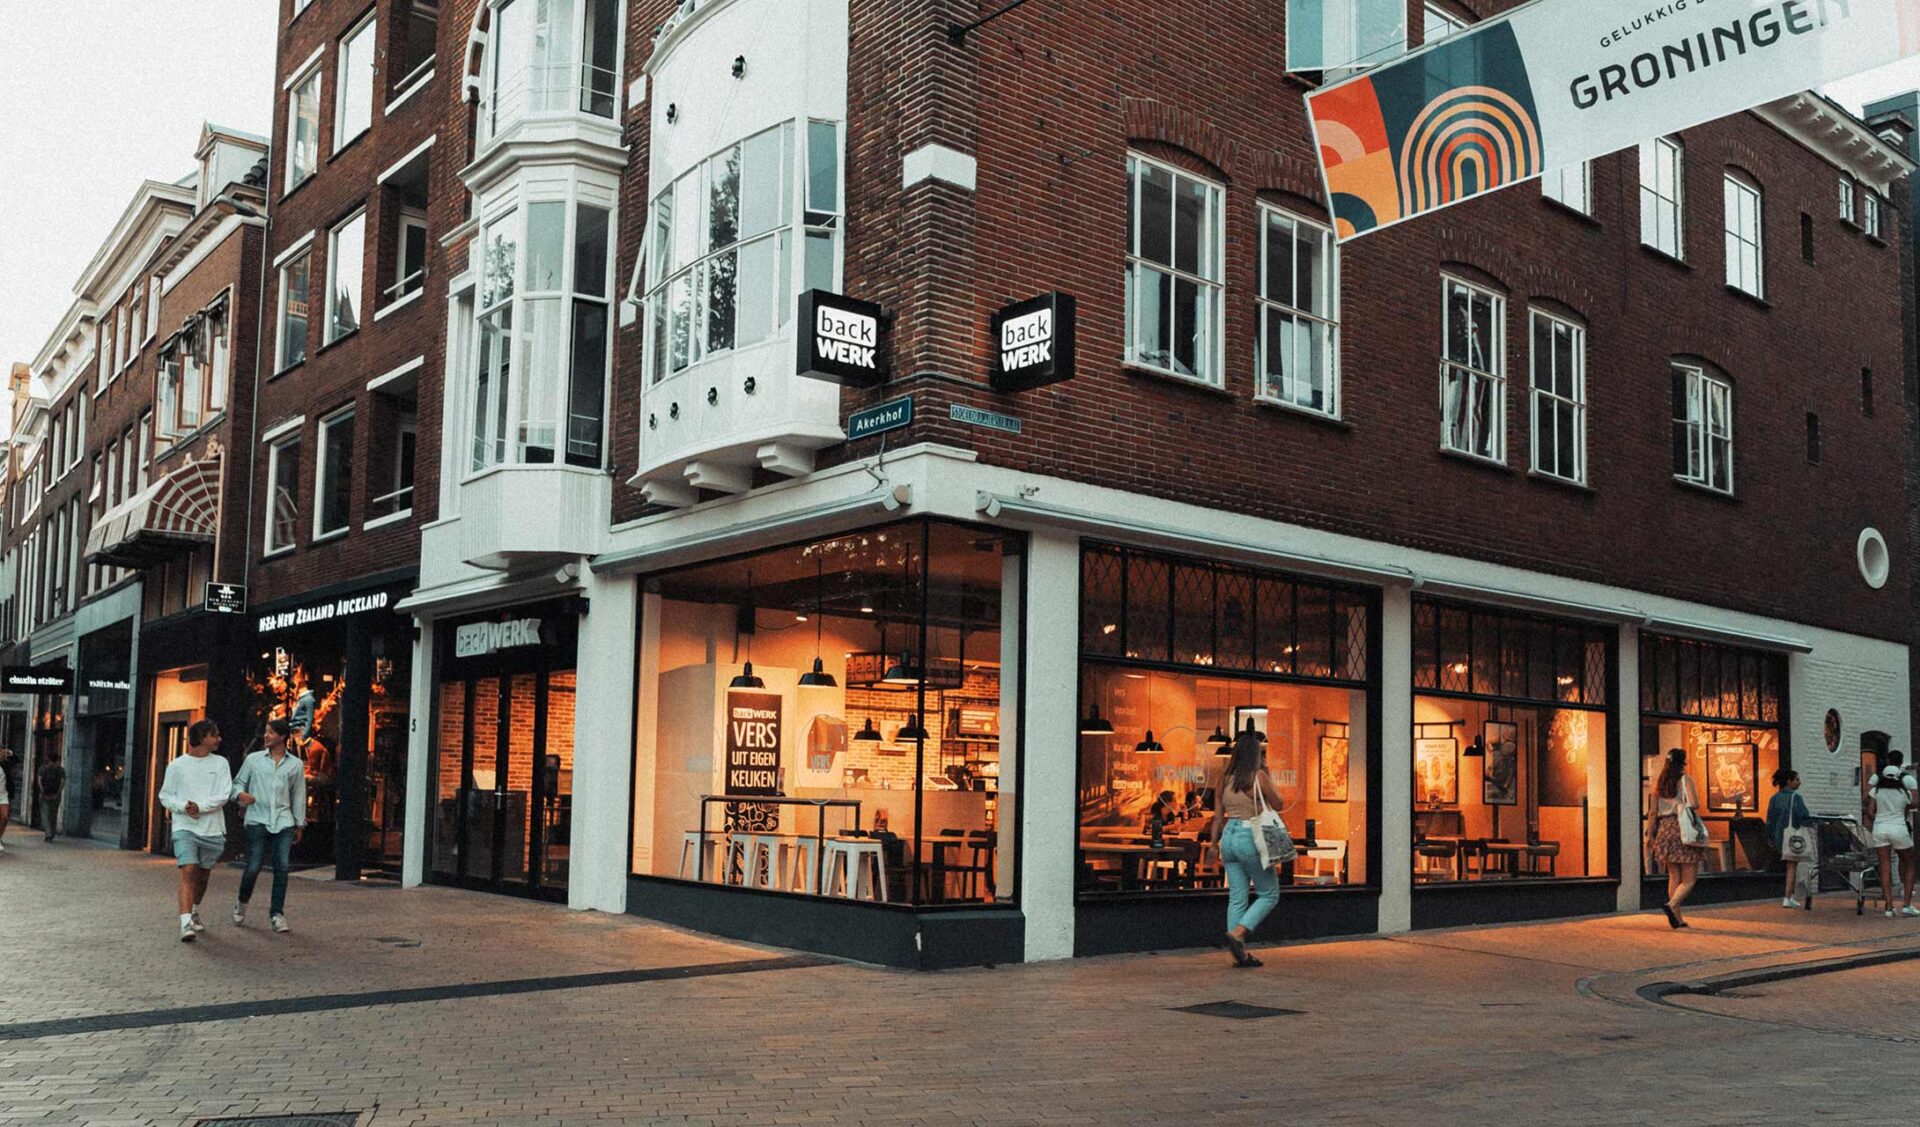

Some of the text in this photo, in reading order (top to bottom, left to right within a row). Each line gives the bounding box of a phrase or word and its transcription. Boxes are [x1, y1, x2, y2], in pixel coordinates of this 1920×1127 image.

[1600, 0, 1687, 48] GELUKKIG
[821, 309, 871, 342] back
[1006, 314, 1048, 346] back
[816, 336, 876, 369] WERK
[1001, 340, 1051, 372] WERK
[856, 407, 902, 431] Akerkhof
[411, 718, 417, 732] 5
[733, 721, 777, 748] VERS
[732, 751, 776, 766] UIT EIGEN
[731, 770, 776, 788] KEUKEN
